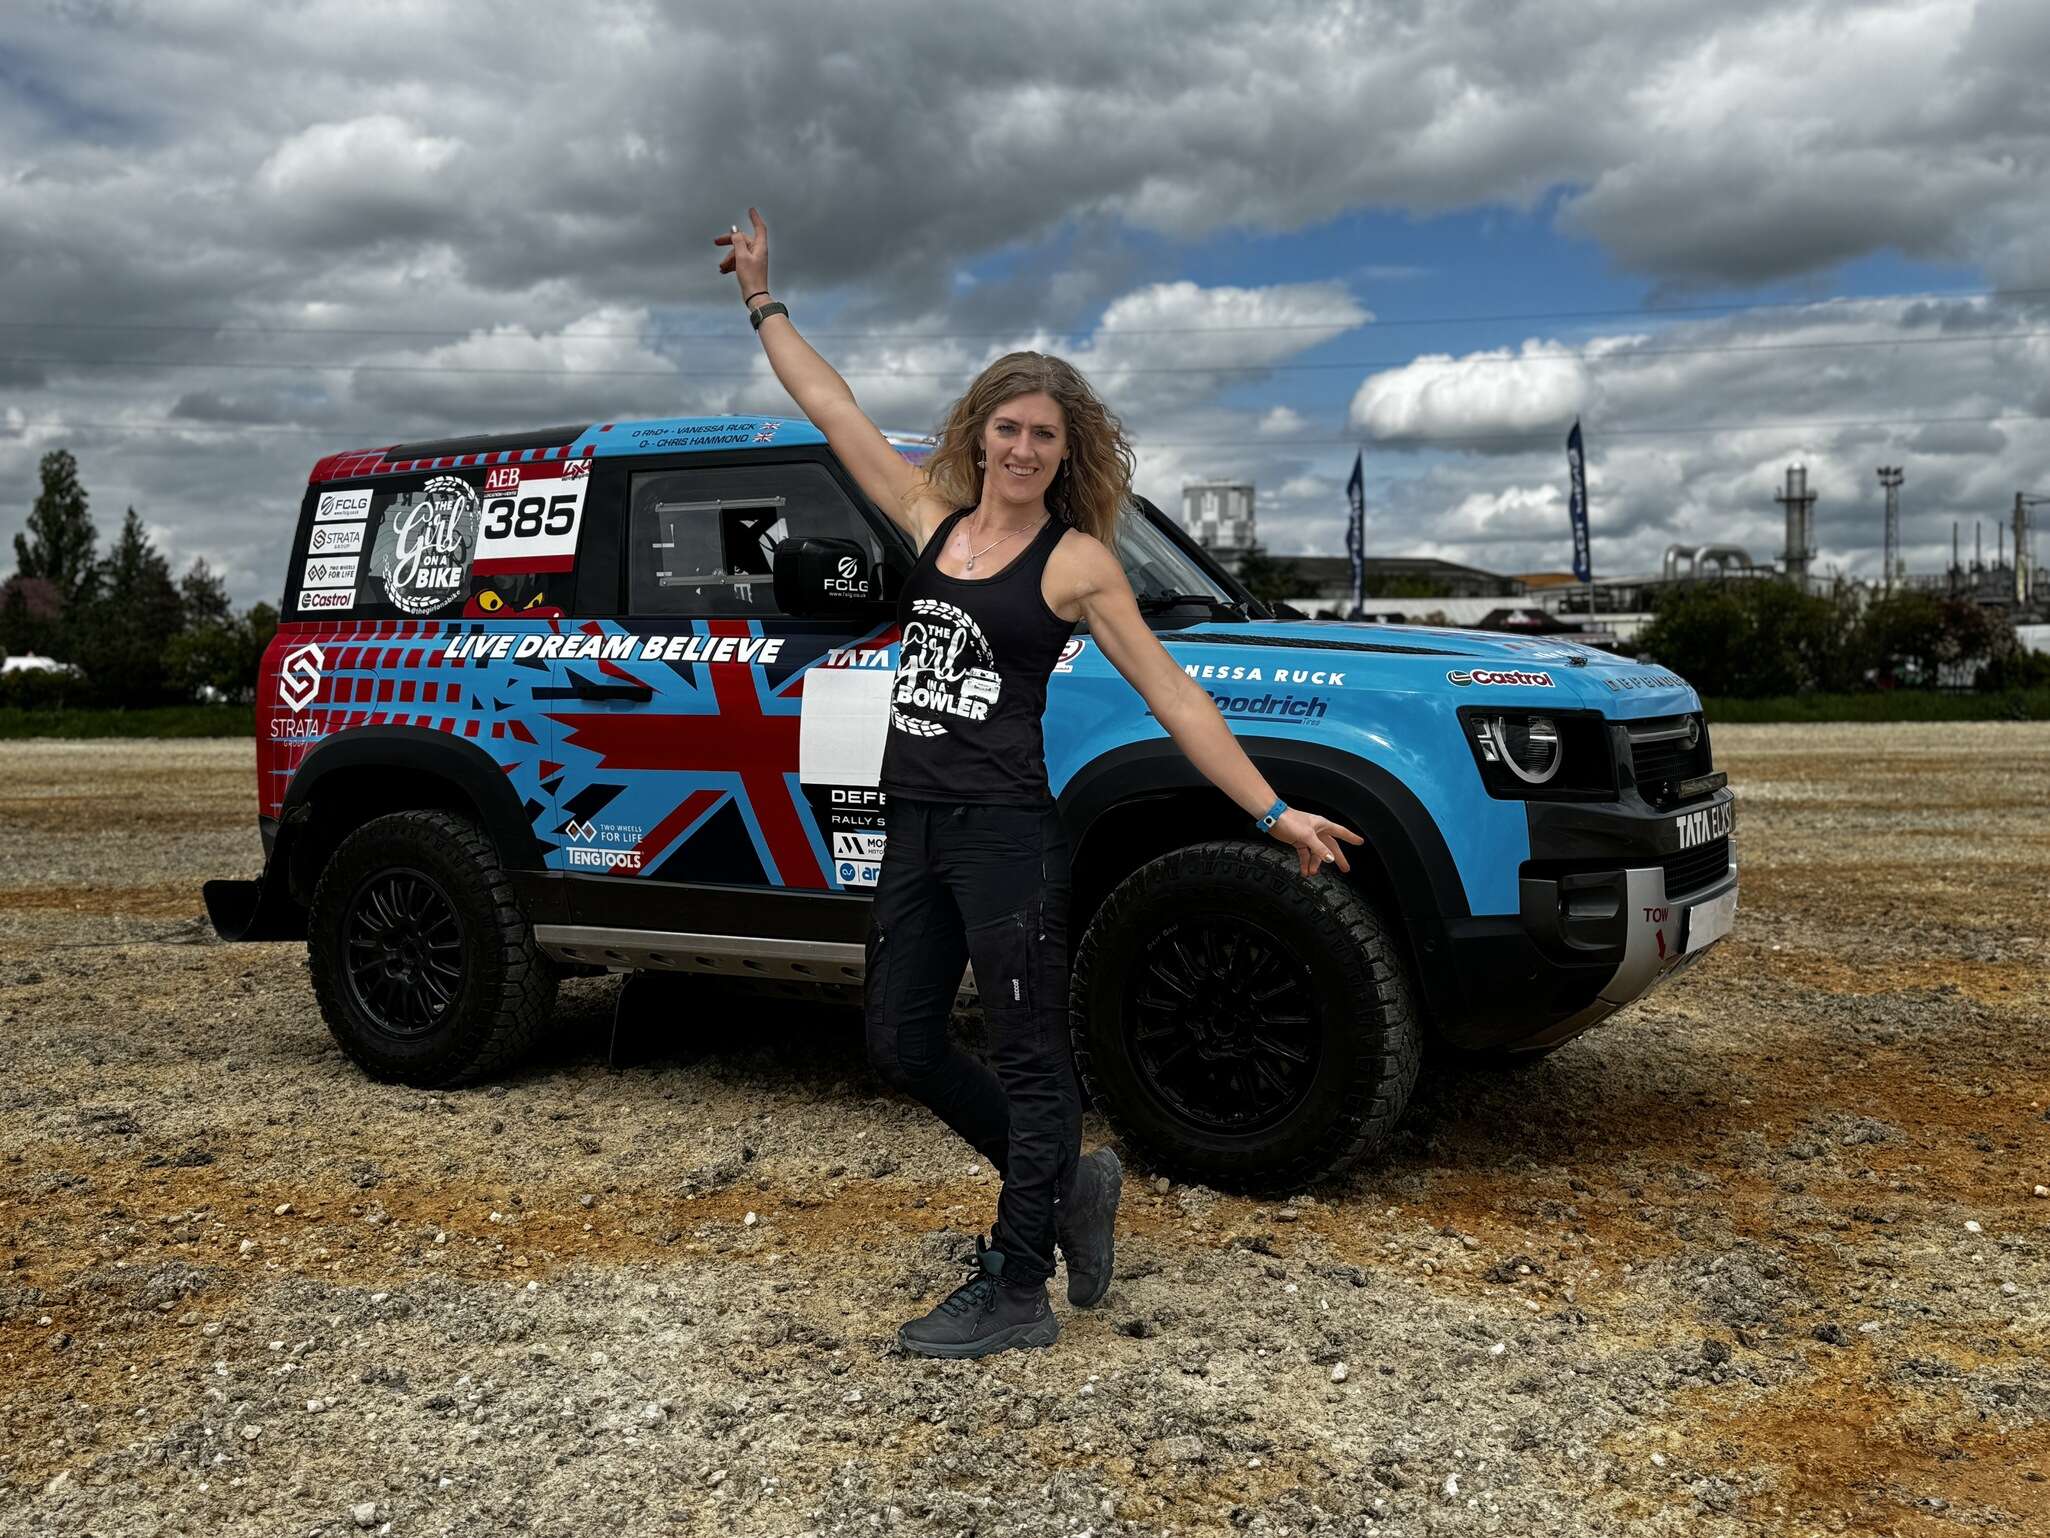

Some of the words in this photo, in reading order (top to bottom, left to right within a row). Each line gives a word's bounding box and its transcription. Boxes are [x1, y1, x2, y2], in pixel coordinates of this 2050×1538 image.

[677, 424, 724, 434] VANESSA
[726, 423, 757, 432] RUCK
[657, 437, 687, 447] CHRIS
[689, 434, 750, 445] HAMMOND
[485, 467, 520, 489] AEB
[335, 498, 368, 510] FCLG
[434, 501, 453, 511] THE
[484, 494, 578, 539] 385
[326, 532, 360, 544] STRATA
[393, 495, 465, 588] Girl
[423, 556, 439, 566] ON
[440, 555, 447, 565] A
[328, 571, 341, 579] FOR
[415, 567, 462, 589] BIKE
[823, 578, 869, 592] FCLG
[312, 593, 351, 607] Castrol
[927, 624, 951, 639] THE
[443, 634, 517, 659] LIVE
[514, 634, 640, 660] DREAM
[640, 636, 786, 664] BELIEVE
[894, 621, 968, 691] Girl
[827, 648, 889, 667] TATA
[1273, 669, 1346, 686] RUCK
[1472, 670, 1554, 687] Castrol
[927, 679, 937, 691] IN
[938, 682, 947, 693] A
[897, 685, 988, 721] BOWLER
[270, 719, 318, 738] STRATA
[831, 815, 872, 826] RALLY
[617, 825, 642, 833] WHEELS
[1676, 810, 1711, 849] TATA
[601, 832, 620, 842] FOR
[623, 834, 643, 843] LIFE
[1643, 908, 1669, 923] TOW
